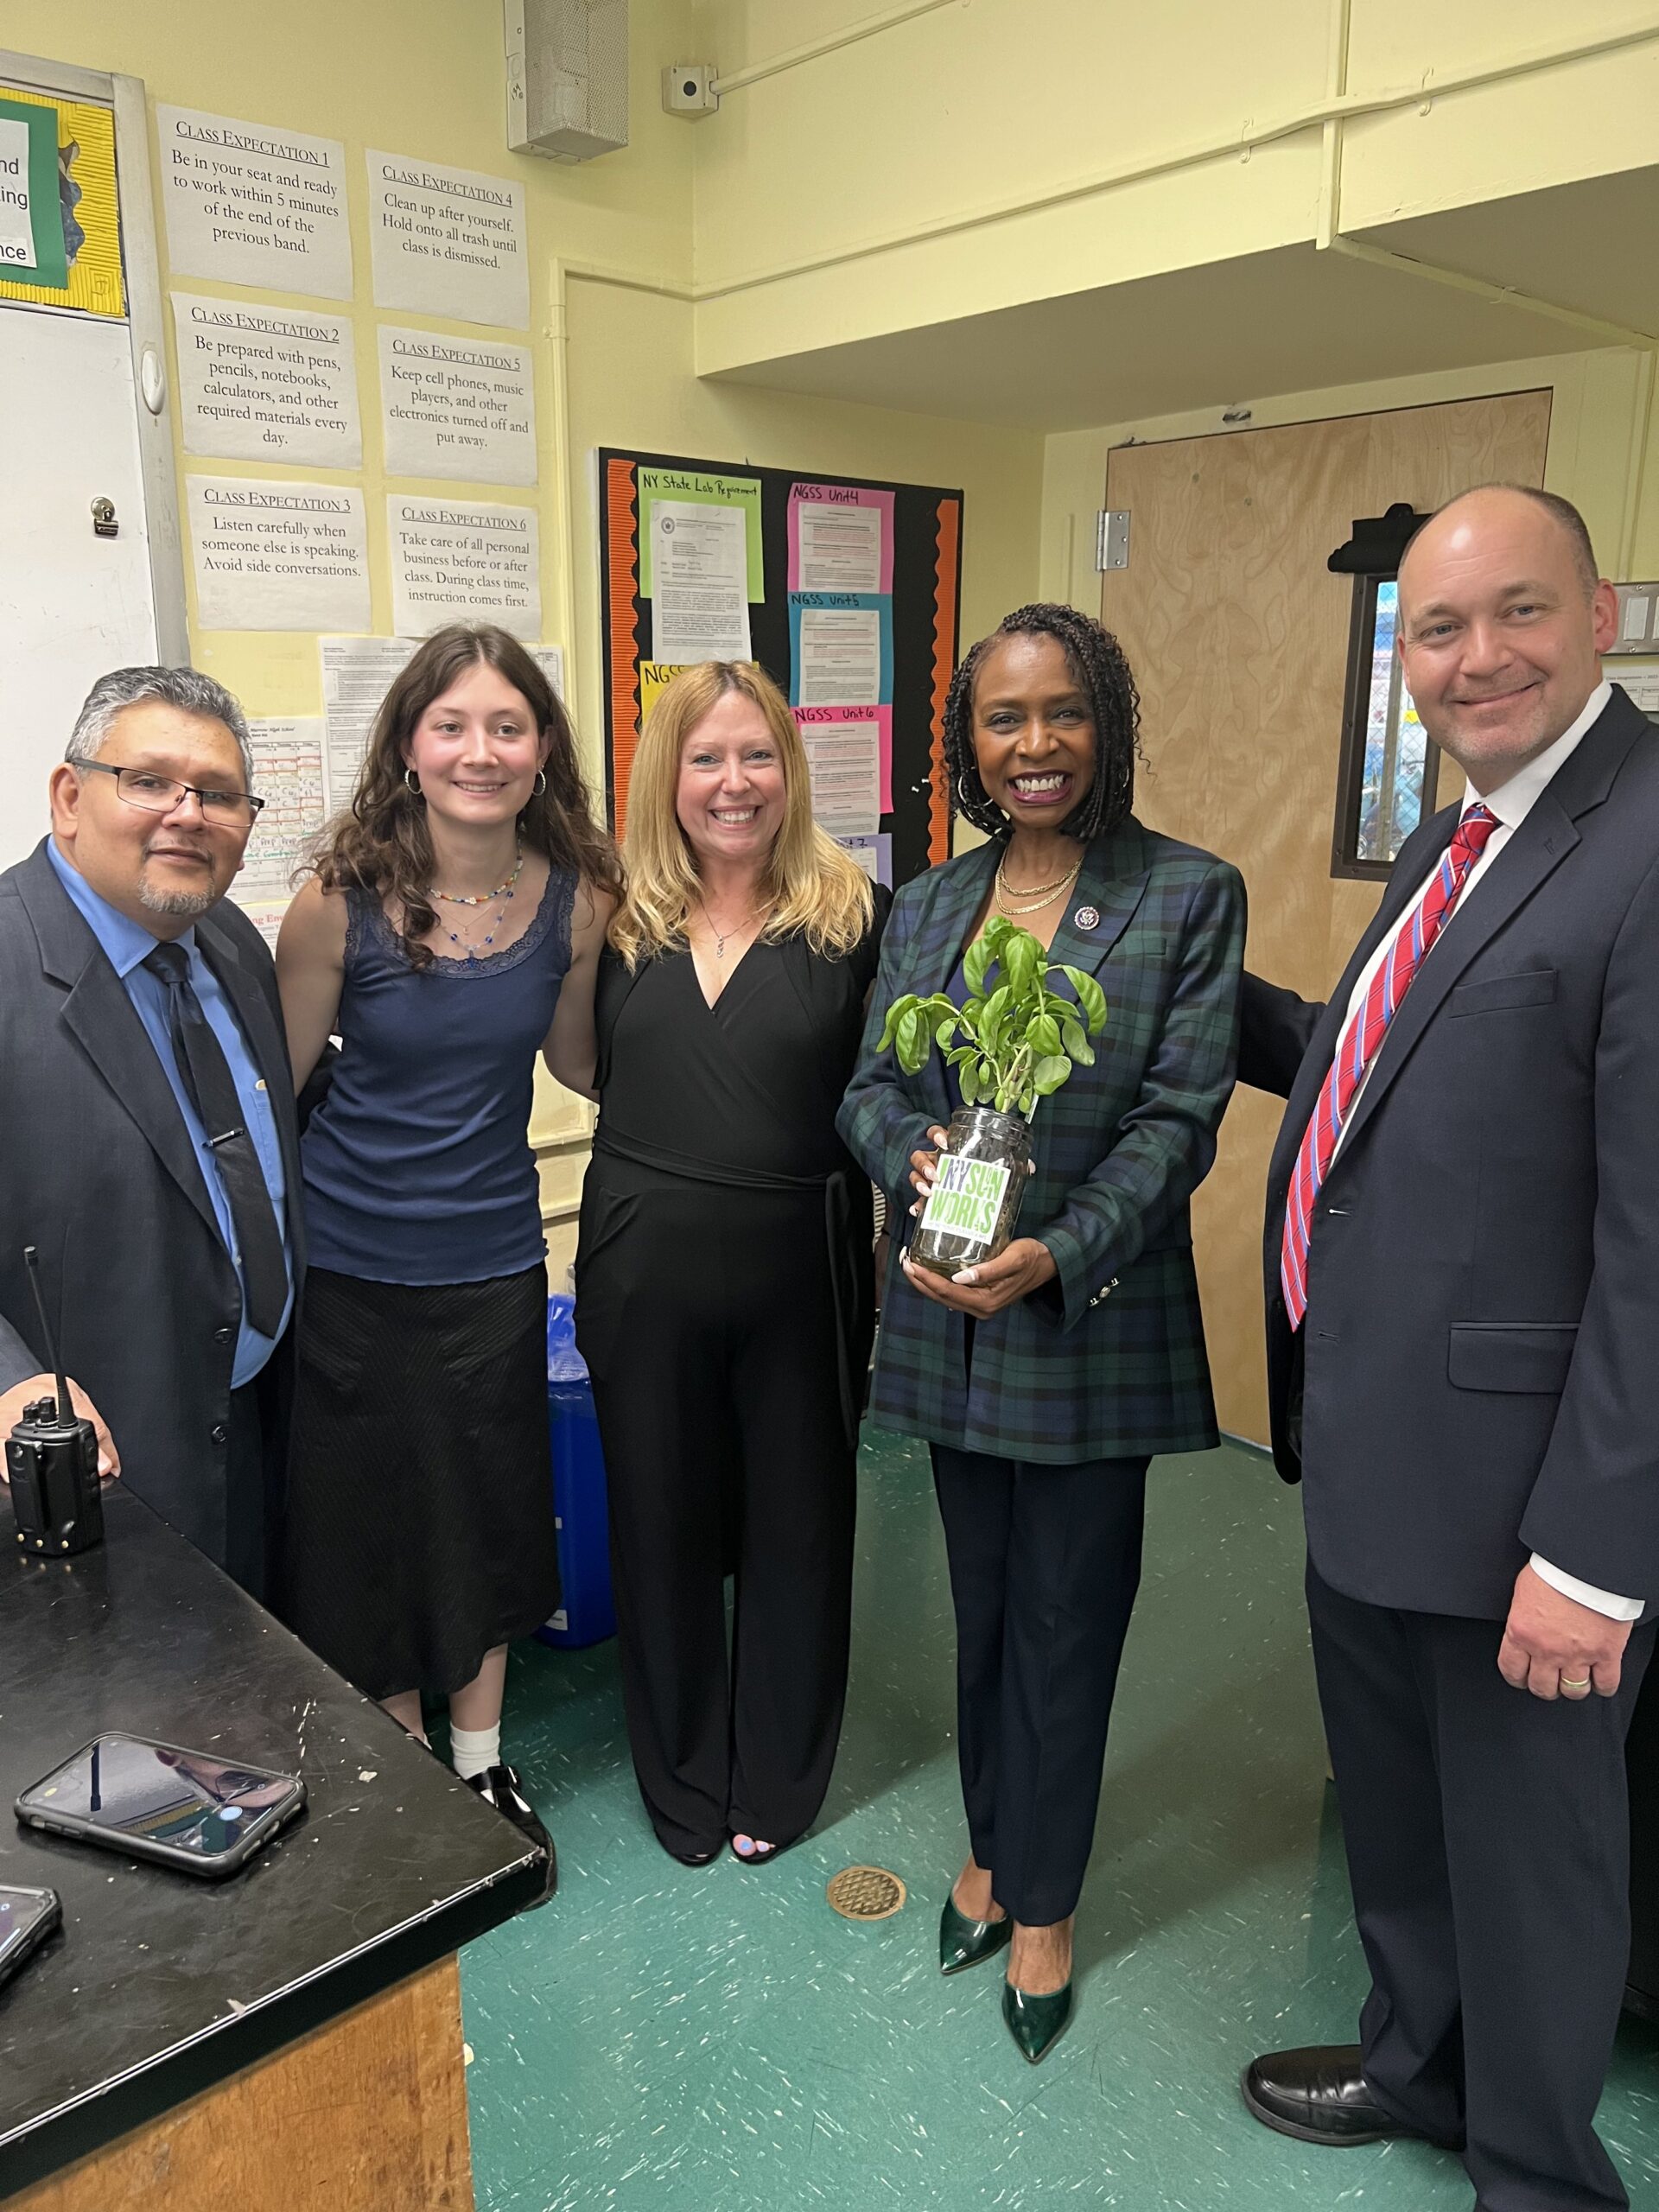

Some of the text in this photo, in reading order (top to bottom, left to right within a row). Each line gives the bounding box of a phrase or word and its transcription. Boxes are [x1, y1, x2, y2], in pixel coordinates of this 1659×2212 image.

[176, 121, 328, 165] CLASS EXPECTATION 1
[172, 149, 337, 199] Be in your seat and ready
[383, 165, 512, 206] CLASS EXPECTATION 4
[174, 175, 339, 217] to work within 5 minutes
[204, 202, 315, 232] of the end of the
[385, 193, 514, 232] Clean up after yourself.
[213, 227, 309, 253] previous band.
[383, 213, 517, 252] Hold onto all trash until
[403, 239, 500, 269] class is dismissed.
[191, 307, 339, 341] CLASS EXPECTATION 2
[195, 335, 341, 372] Be prepared with pens,
[393, 340, 520, 370] CLASS EXPECTATION 5
[209, 362, 331, 391] pencils, notebooks,
[391, 365, 524, 396] Keep cell phones, music
[204, 382, 339, 410] calculators, and other
[411, 389, 507, 412] players, and other
[198, 404, 346, 434] required materials every
[390, 406, 529, 433] electronics turned off and
[263, 429, 289, 448] day.
[436, 433, 487, 449] put away.
[643, 474, 658, 488] NY
[664, 475, 691, 490] State
[696, 477, 713, 493] Lab
[794, 485, 823, 499] NGSS
[204, 488, 351, 512] CLASS EXPECTATION 3
[213, 517, 346, 538] Listen carefully when
[402, 507, 526, 530] CLASS EXPECTATION 6
[202, 540, 359, 561] someone else is speaking.
[400, 532, 530, 555] Take care of all personal
[203, 556, 361, 577] Avoid side conversations.
[404, 551, 527, 572] business before or after
[405, 570, 529, 592] class. During class time,
[409, 589, 528, 607] instruction comes first.
[791, 594, 823, 605] NGSS
[795, 709, 833, 722] NGSS
